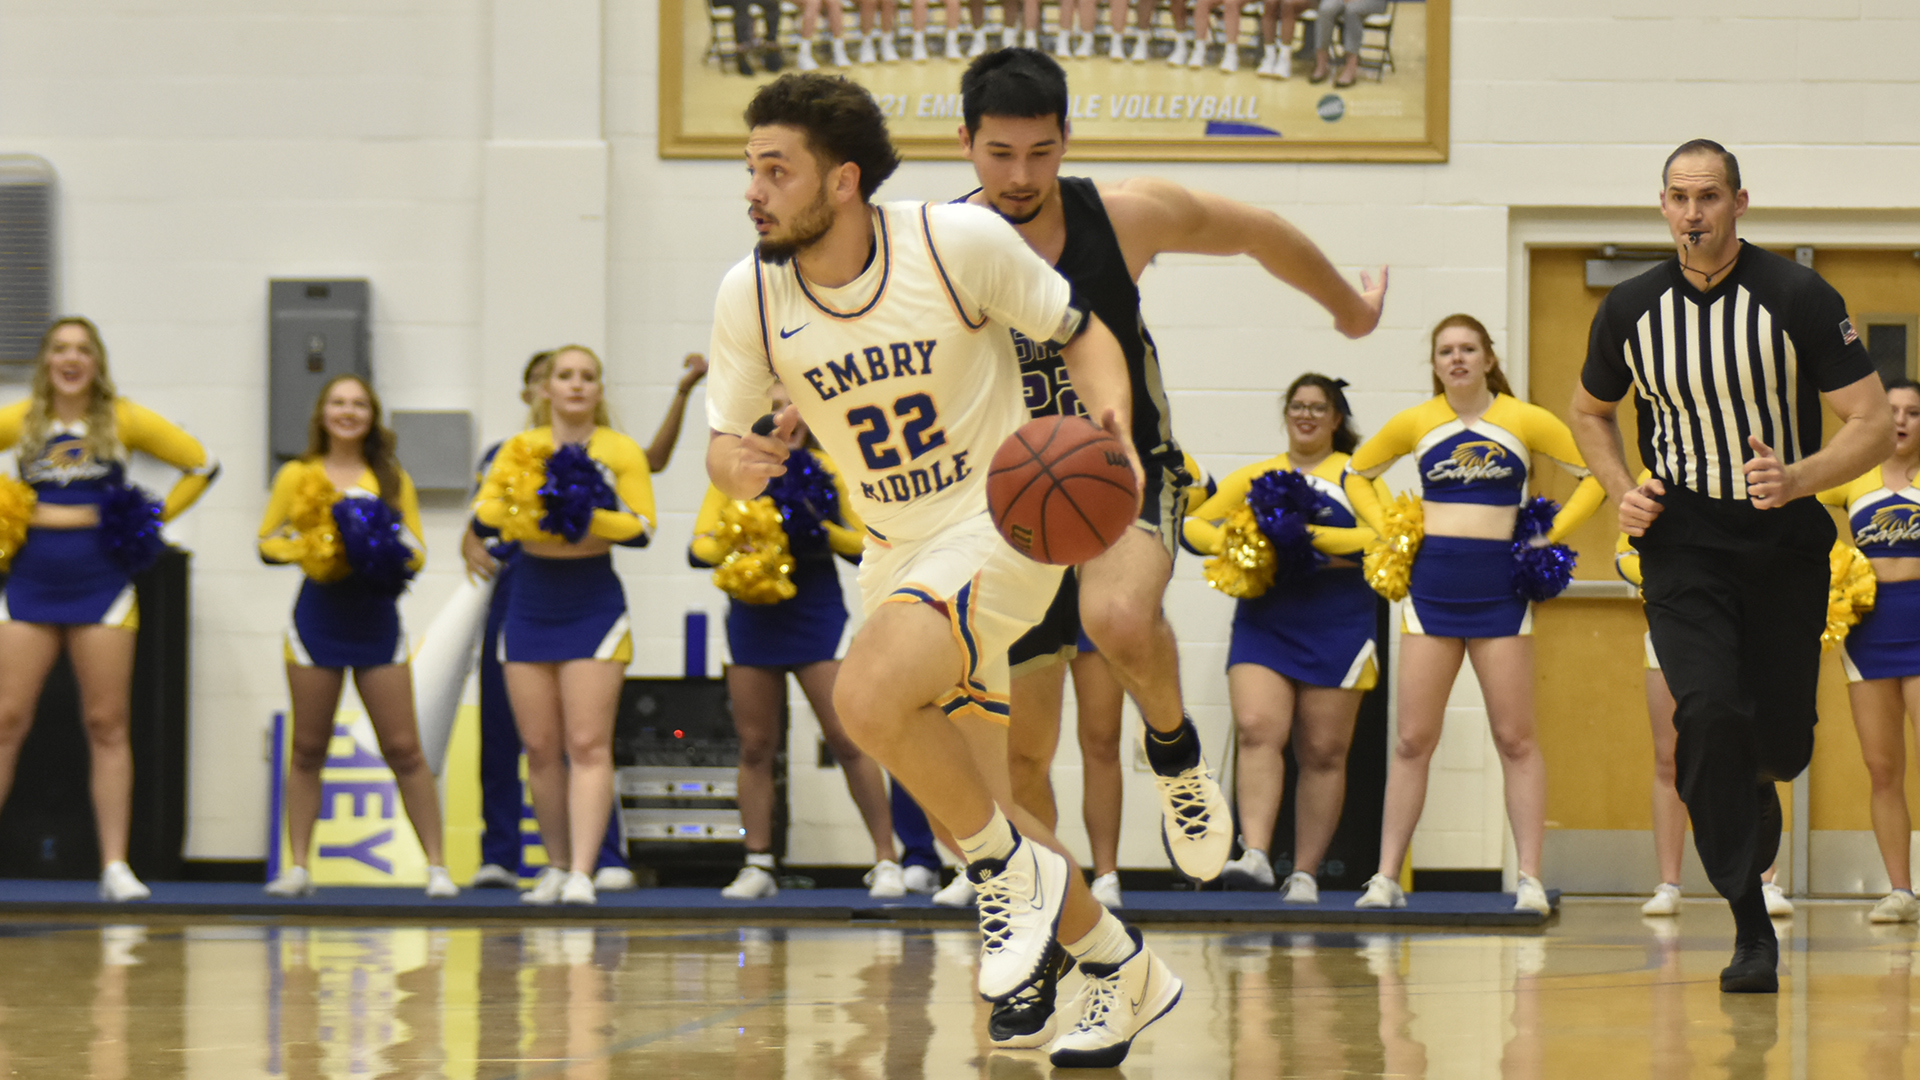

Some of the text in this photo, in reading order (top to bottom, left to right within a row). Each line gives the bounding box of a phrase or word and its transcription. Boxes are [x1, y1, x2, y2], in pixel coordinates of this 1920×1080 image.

[1110, 94, 1260, 119] VOLLEYBALL
[803, 339, 937, 401] EMBRY
[846, 392, 948, 471] 22
[1426, 458, 1513, 485] Eagles
[1855, 521, 1920, 548] Eagle
